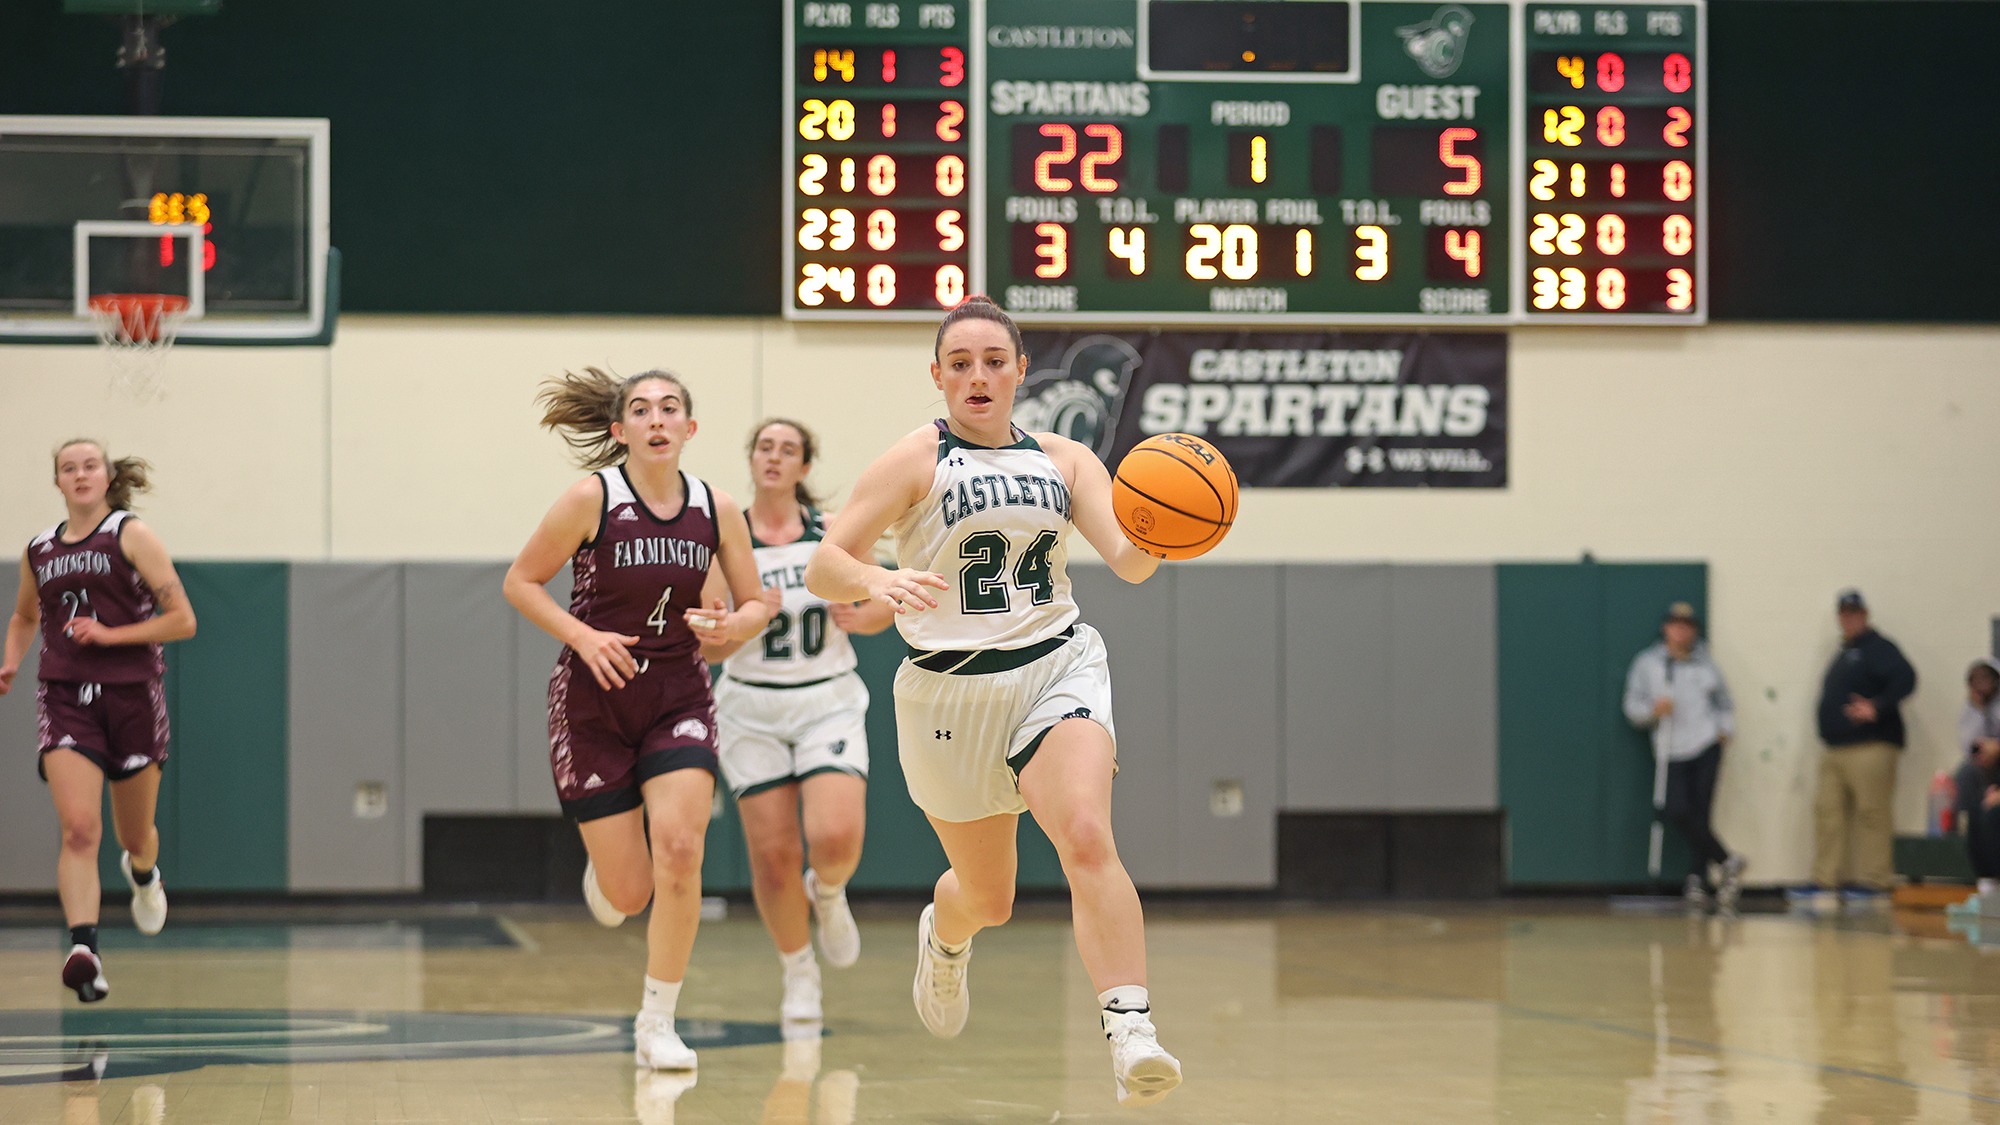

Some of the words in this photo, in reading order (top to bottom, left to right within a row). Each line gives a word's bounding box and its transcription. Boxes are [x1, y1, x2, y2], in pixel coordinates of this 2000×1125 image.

[803, 2, 851, 28] PLYR
[919, 4, 955, 29] PTS
[988, 25, 1134, 49] CASTLETON
[1648, 11, 1682, 35] PTS
[813, 48, 855, 82] 14
[882, 49, 896, 83] 1
[939, 46, 964, 86] 3
[1557, 56, 1585, 89] 4
[1596, 53, 1625, 93] 0
[1663, 53, 1691, 93] 0
[991, 80, 1150, 116] SPARTANS
[1211, 101, 1290, 126] PERIOD
[1376, 84, 1480, 120] GUEST
[799, 99, 855, 141] 20
[881, 103, 896, 137] 1
[936, 100, 964, 142] 2
[1543, 105, 1585, 147] 12
[1596, 105, 1626, 147] 0
[1663, 106, 1692, 147] 2
[799, 153, 855, 196] 21
[867, 154, 896, 197] 0
[935, 154, 965, 197] 0
[1034, 123, 1123, 192] 22
[1251, 136, 1267, 183] 1
[1439, 127, 1482, 196] 5
[1529, 159, 1586, 201] 21
[1610, 163, 1626, 198] 1
[1662, 160, 1692, 202] 0
[798, 208, 855, 251] 23
[867, 208, 896, 251] 0
[935, 209, 965, 251] 5
[1006, 199, 1078, 223] FOULS
[1174, 199, 1258, 224] PLAYER
[1266, 200, 1323, 225] FOUL
[1420, 201, 1491, 225] FOULS
[1034, 222, 1068, 279] 3
[1108, 227, 1146, 276] 4
[1185, 224, 1258, 280] 20
[1295, 228, 1312, 277] 1
[1355, 225, 1388, 281] 3
[1444, 229, 1481, 278] 4
[1529, 213, 1586, 256] 22
[1596, 213, 1626, 256] 0
[1662, 214, 1692, 256] 0
[798, 262, 855, 306] 24
[867, 263, 896, 307] 0
[935, 264, 965, 307] 0
[1006, 286, 1079, 311] SCORE
[1420, 288, 1491, 313] SCORE
[1532, 267, 1586, 310] 33
[1596, 267, 1626, 310] 0
[1665, 268, 1692, 310] 3
[1189, 349, 1402, 383] CASTLETON
[1139, 383, 1490, 437] SPARTANS
[959, 529, 1058, 615] 24
[647, 586, 672, 636] 4
[763, 601, 828, 661] 20
